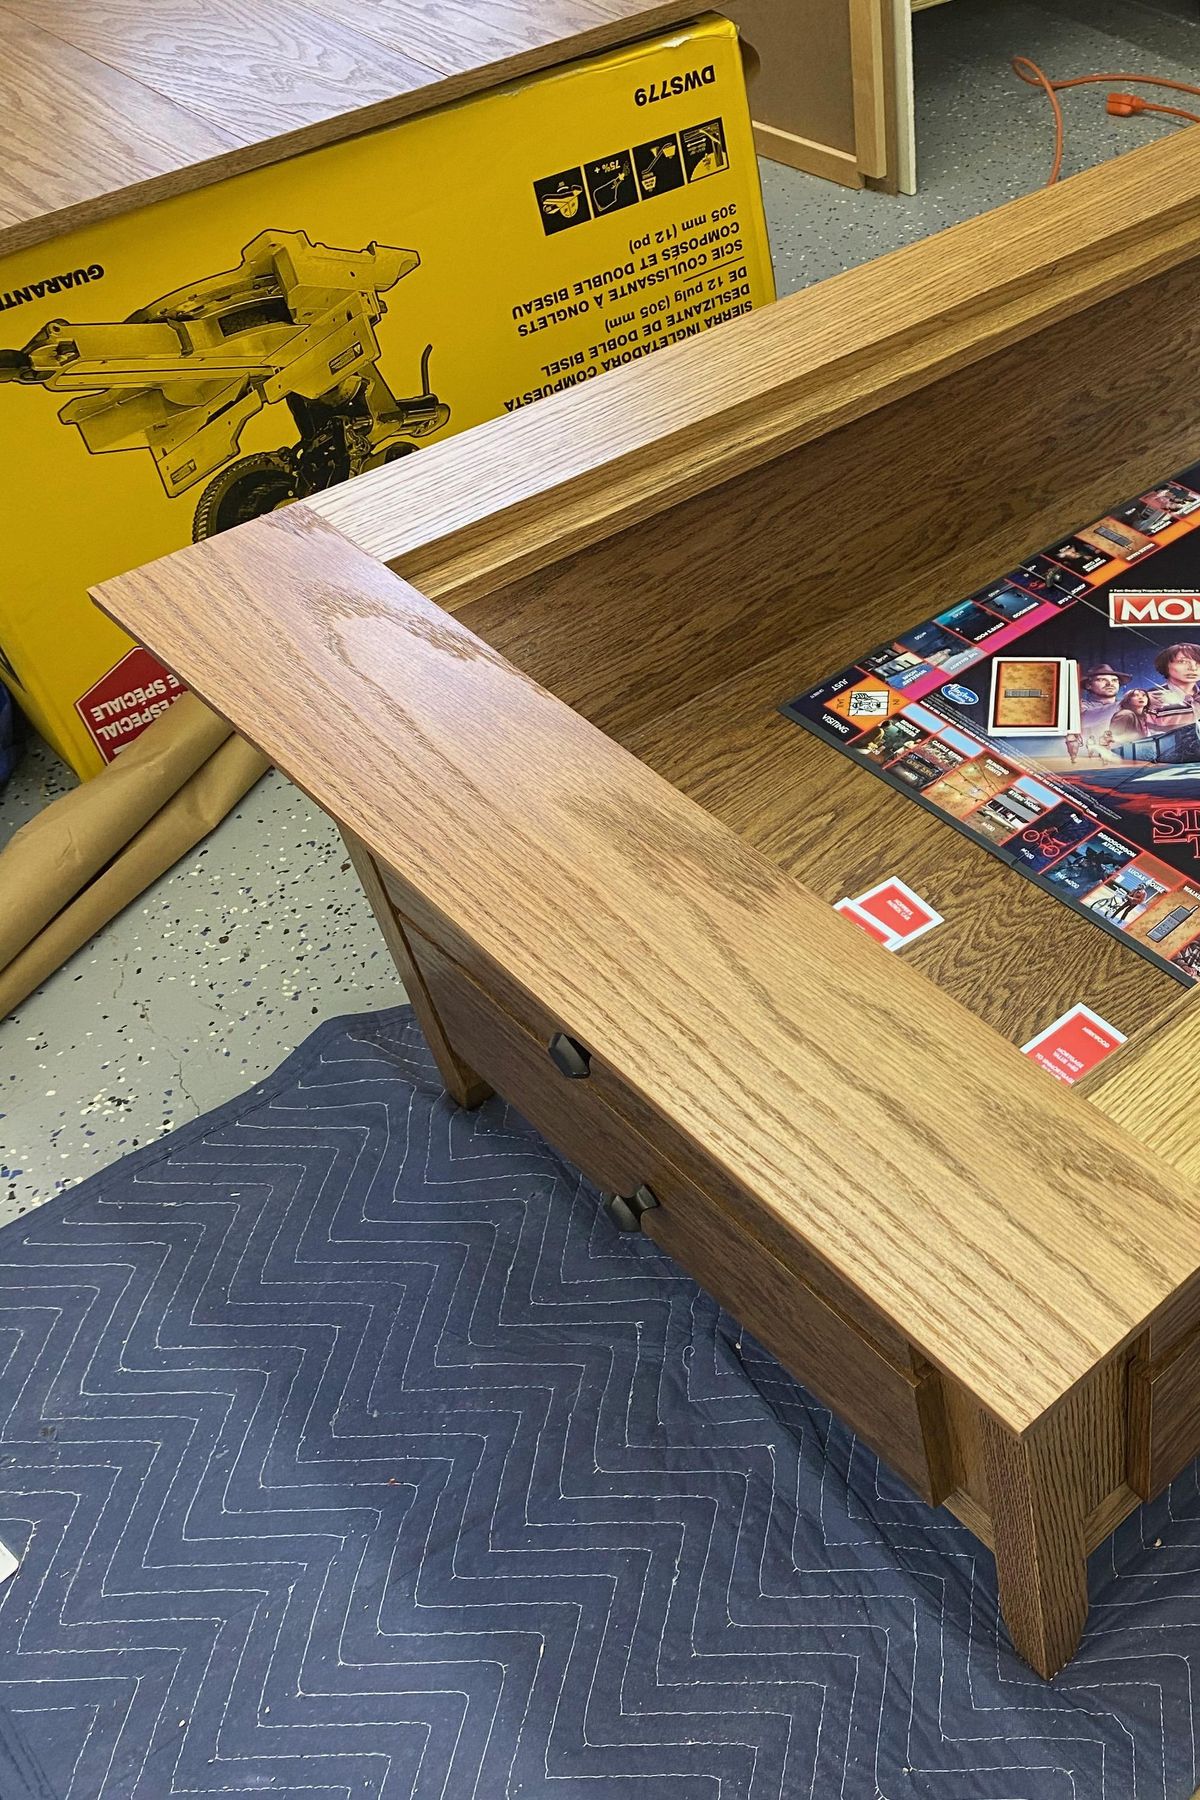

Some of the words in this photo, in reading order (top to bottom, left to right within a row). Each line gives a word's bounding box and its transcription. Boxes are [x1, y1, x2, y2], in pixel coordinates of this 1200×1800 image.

[634, 65, 715, 106] DWS779
[681, 214, 707, 232] mm
[712, 203, 737, 222] 305
[629, 235, 651, 254] po)
[655, 224, 677, 243] (12
[662, 222, 740, 261] COMPOSÉS
[712, 239, 743, 261] SCIE
[640, 255, 659, 271] ET
[729, 266, 748, 283] DE
[574, 262, 635, 295] DOUBLE
[608, 253, 708, 301] COULISSANTE
[708, 275, 724, 290] 12
[512, 288, 569, 319] BISEAU
[593, 295, 603, 309] À
[675, 281, 703, 302] pulg
[640, 295, 670, 319] (305
[666, 284, 750, 326] DESLIZANTE
[703, 300, 753, 330] SIERRA
[517, 300, 590, 336] ONGLETS
[605, 309, 636, 333] mm)
[643, 319, 662, 336] DE
[589, 330, 639, 359] DOBLE
[601, 321, 702, 372] INGLETADORA
[541, 351, 585, 377] BISEL
[503, 366, 598, 412] COMPUESTA
[831, 678, 849, 692] JUST
[90, 679, 167, 722] SPÉCIALE
[96, 700, 170, 740] ESPECIAL
[821, 713, 850, 734] VISITING
[1097, 832, 1137, 858] DEMOGORGON
[1101, 841, 1124, 856] ATTACK
